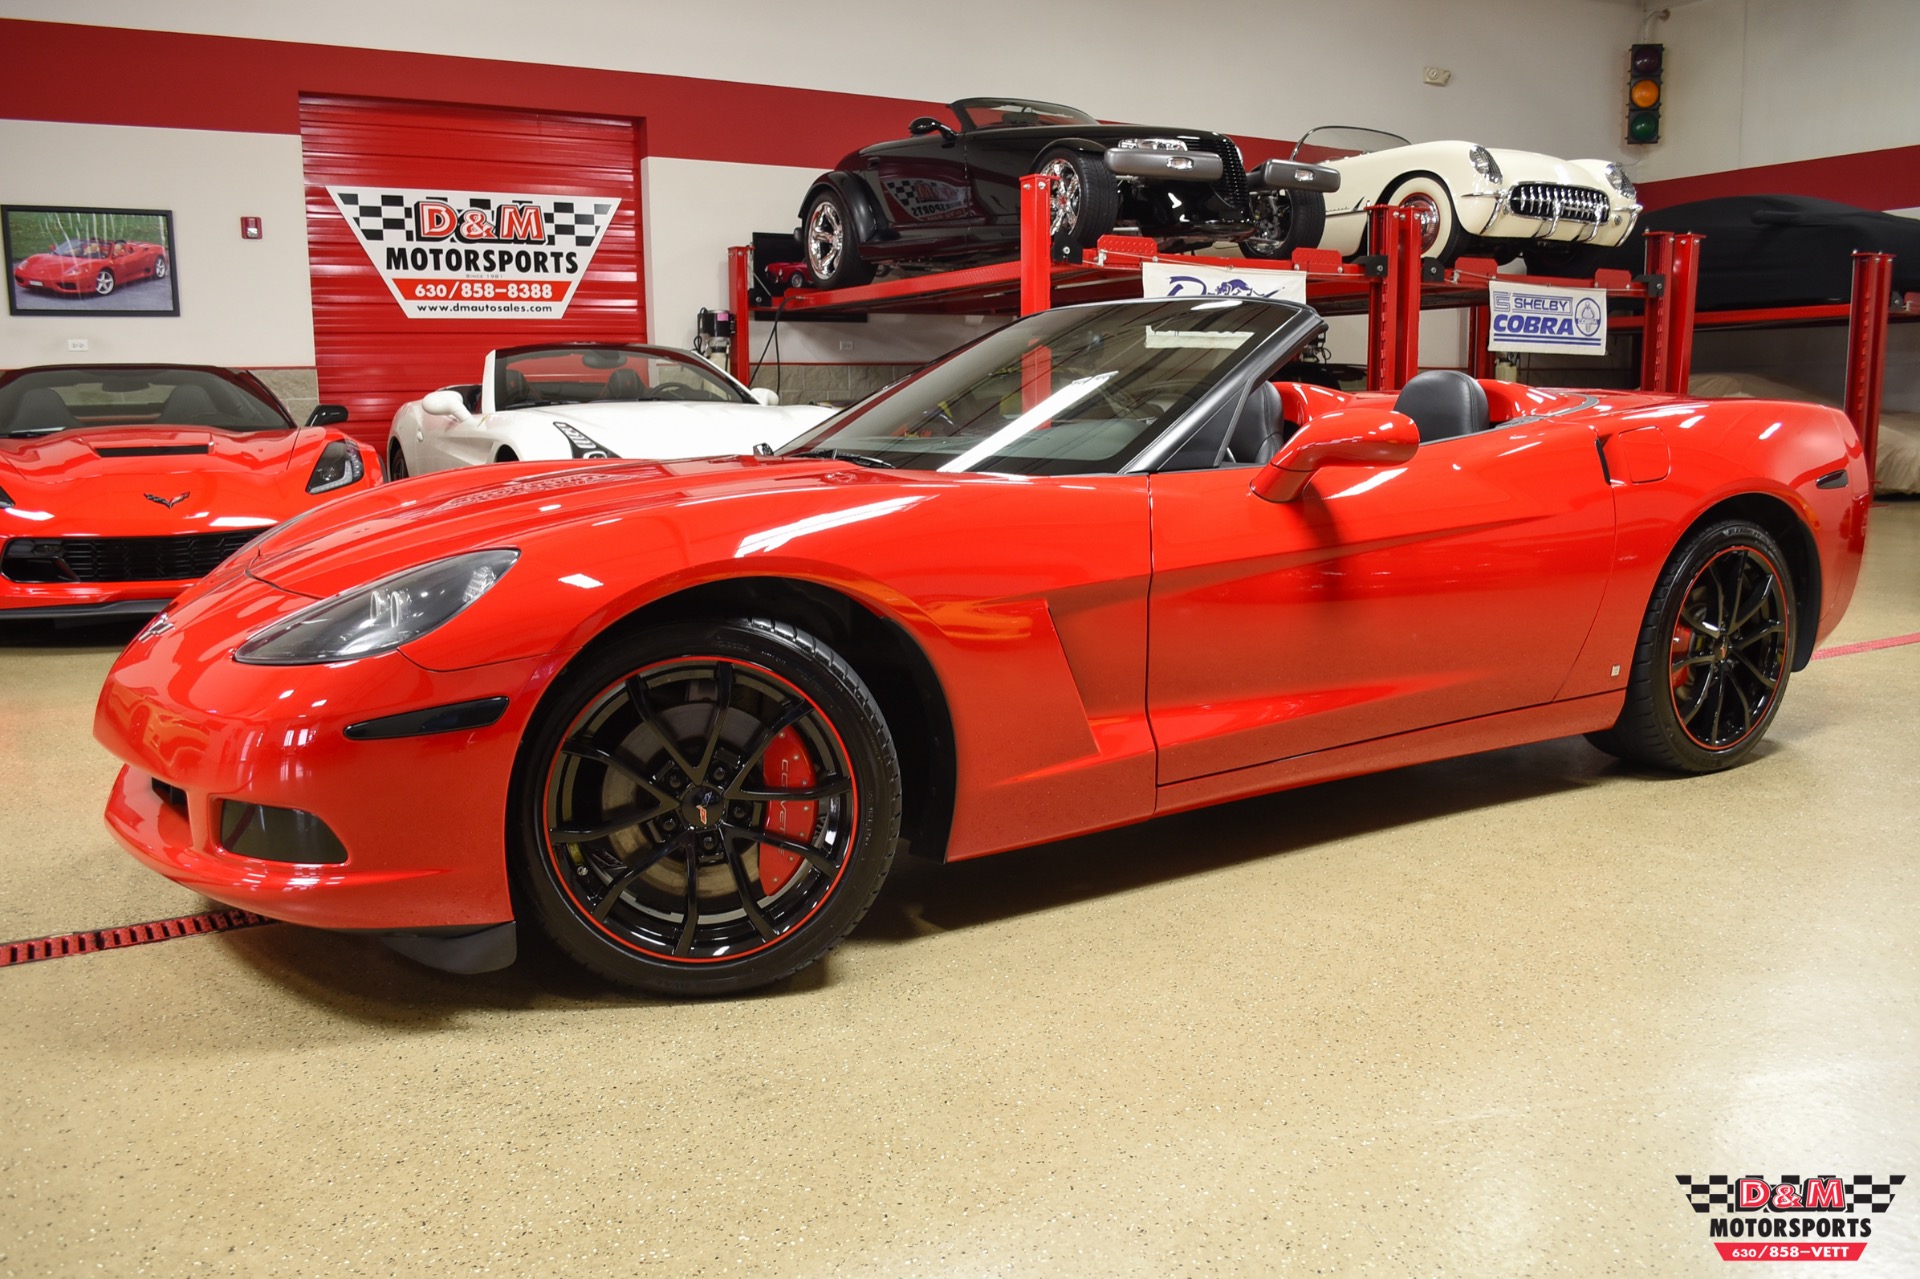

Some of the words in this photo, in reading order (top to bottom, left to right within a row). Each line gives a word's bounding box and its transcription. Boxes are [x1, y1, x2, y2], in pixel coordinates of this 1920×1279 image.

[416, 200, 548, 244] D&M
[386, 247, 579, 274] MOTORSPORTS
[414, 281, 553, 299] 630/858-8388
[416, 302, 553, 313] www.dmautosales.com
[1514, 297, 1568, 311] SHELBY
[1493, 314, 1574, 335] COBRA
